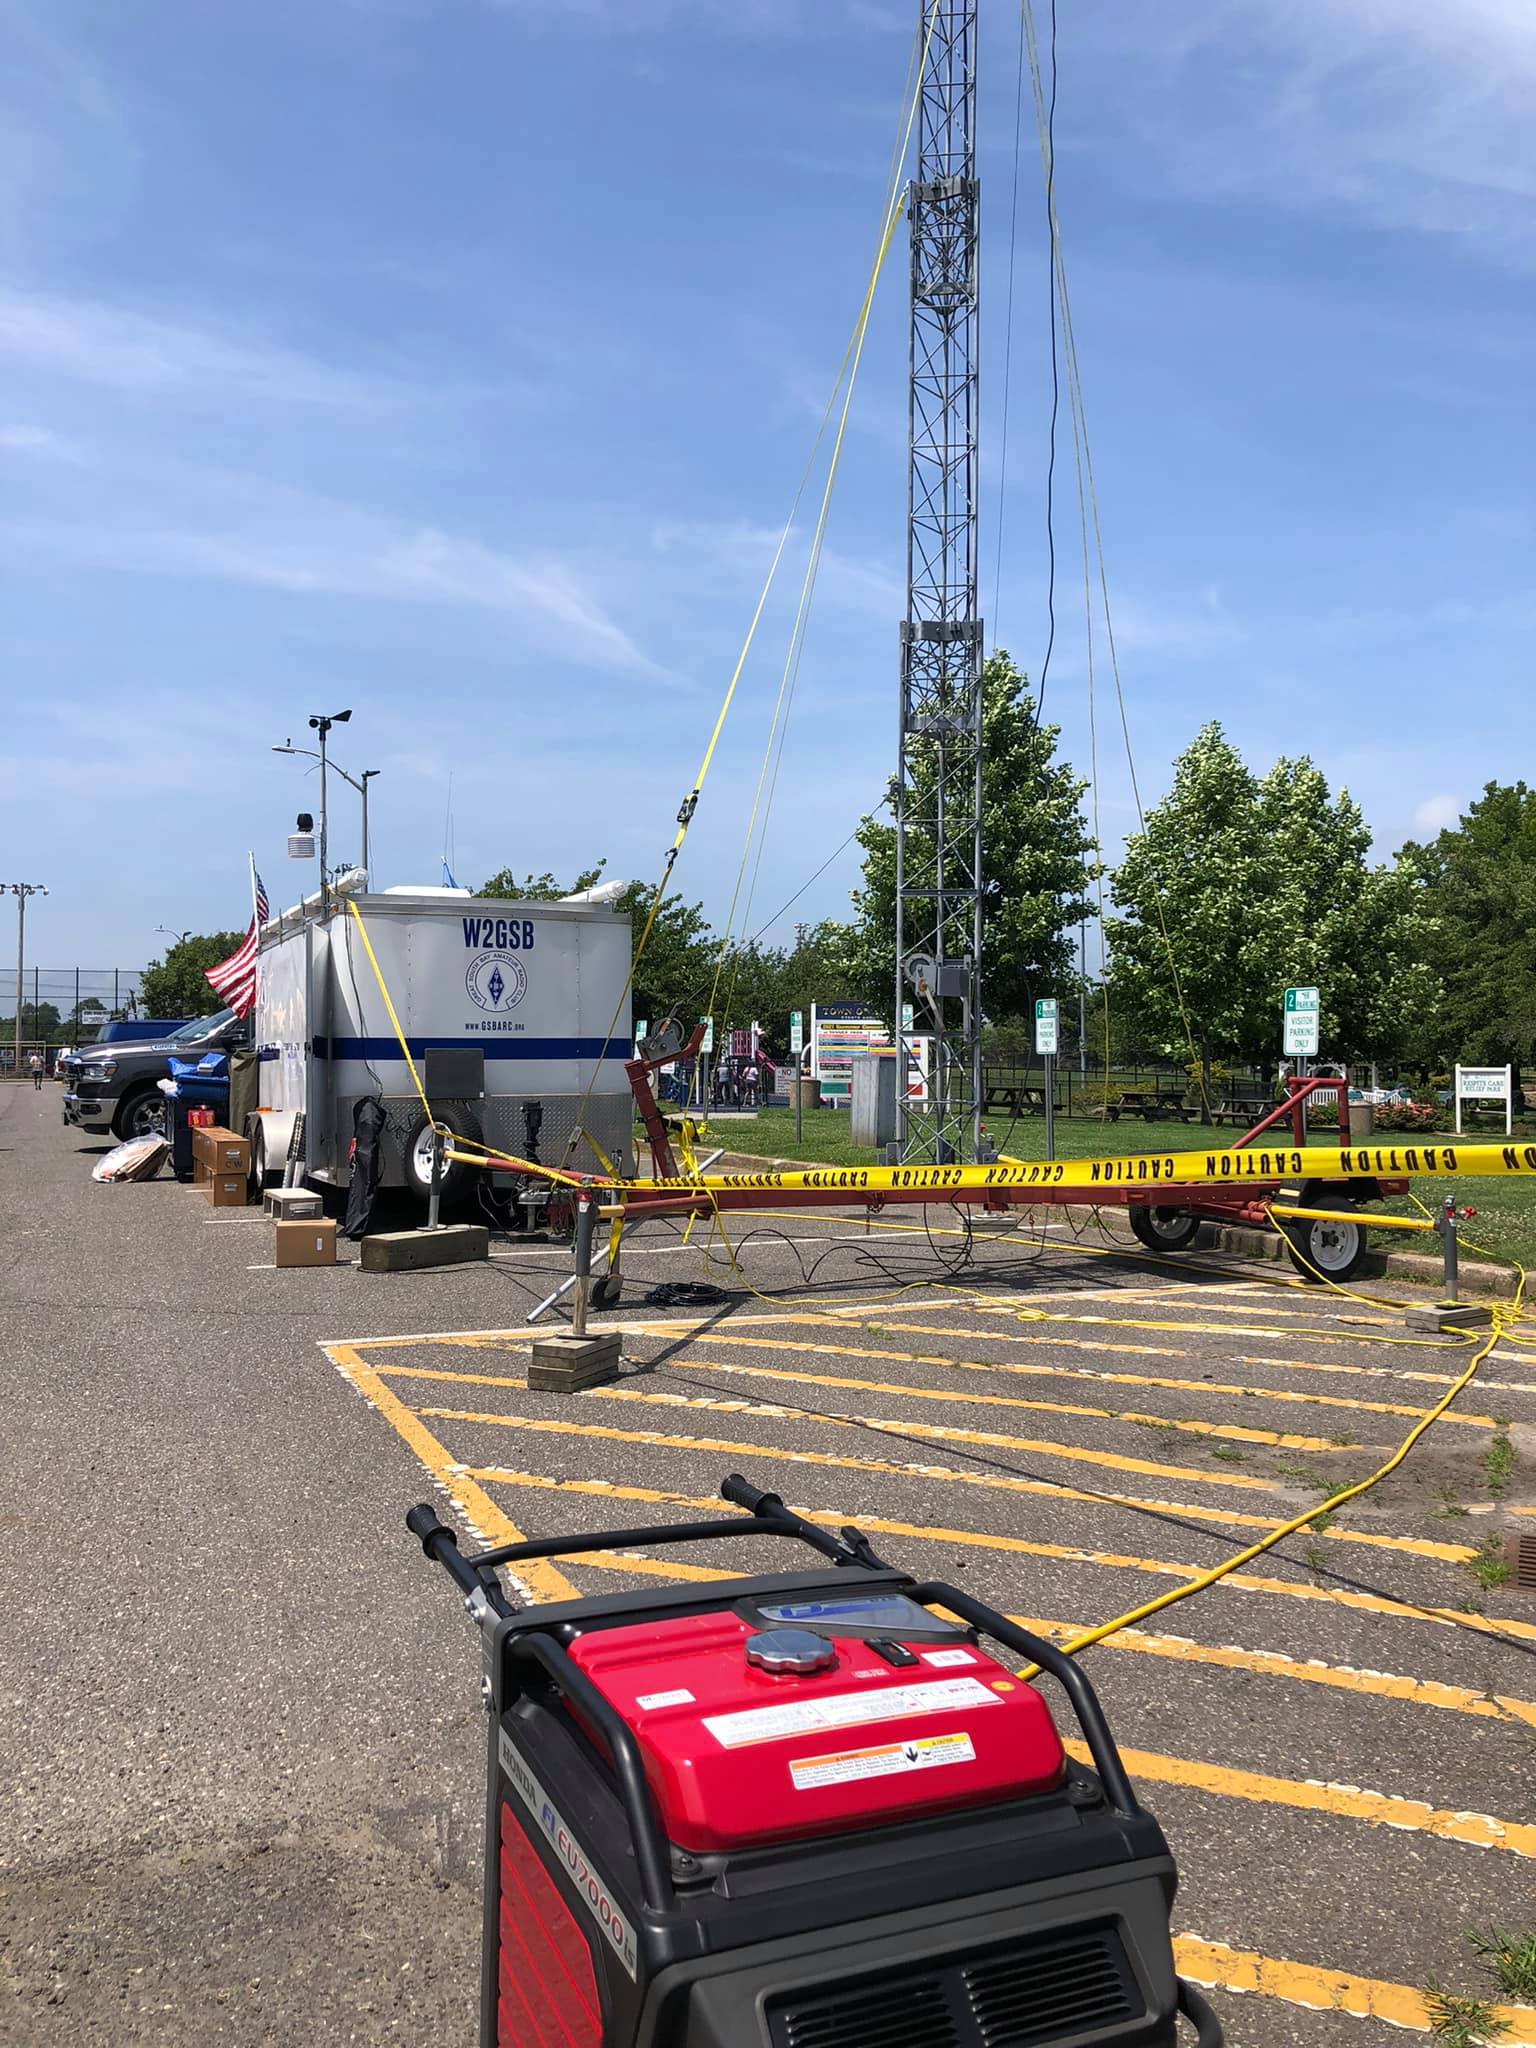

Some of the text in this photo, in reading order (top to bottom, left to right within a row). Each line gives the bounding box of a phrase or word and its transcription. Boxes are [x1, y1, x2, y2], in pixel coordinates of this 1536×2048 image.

[463, 918, 534, 949] W2GSB
[1288, 994, 1294, 1007] 2
[1091, 1158, 1174, 1181] CAUTION
[1206, 1151, 1303, 1176] CAUTION
[1340, 1147, 1458, 1173] CAUTION
[802, 1171, 868, 1187] CAUTION
[891, 1170, 963, 1186] CAUTION
[985, 1165, 1065, 1183] CAUTION
[503, 1743, 537, 1806] HONDA
